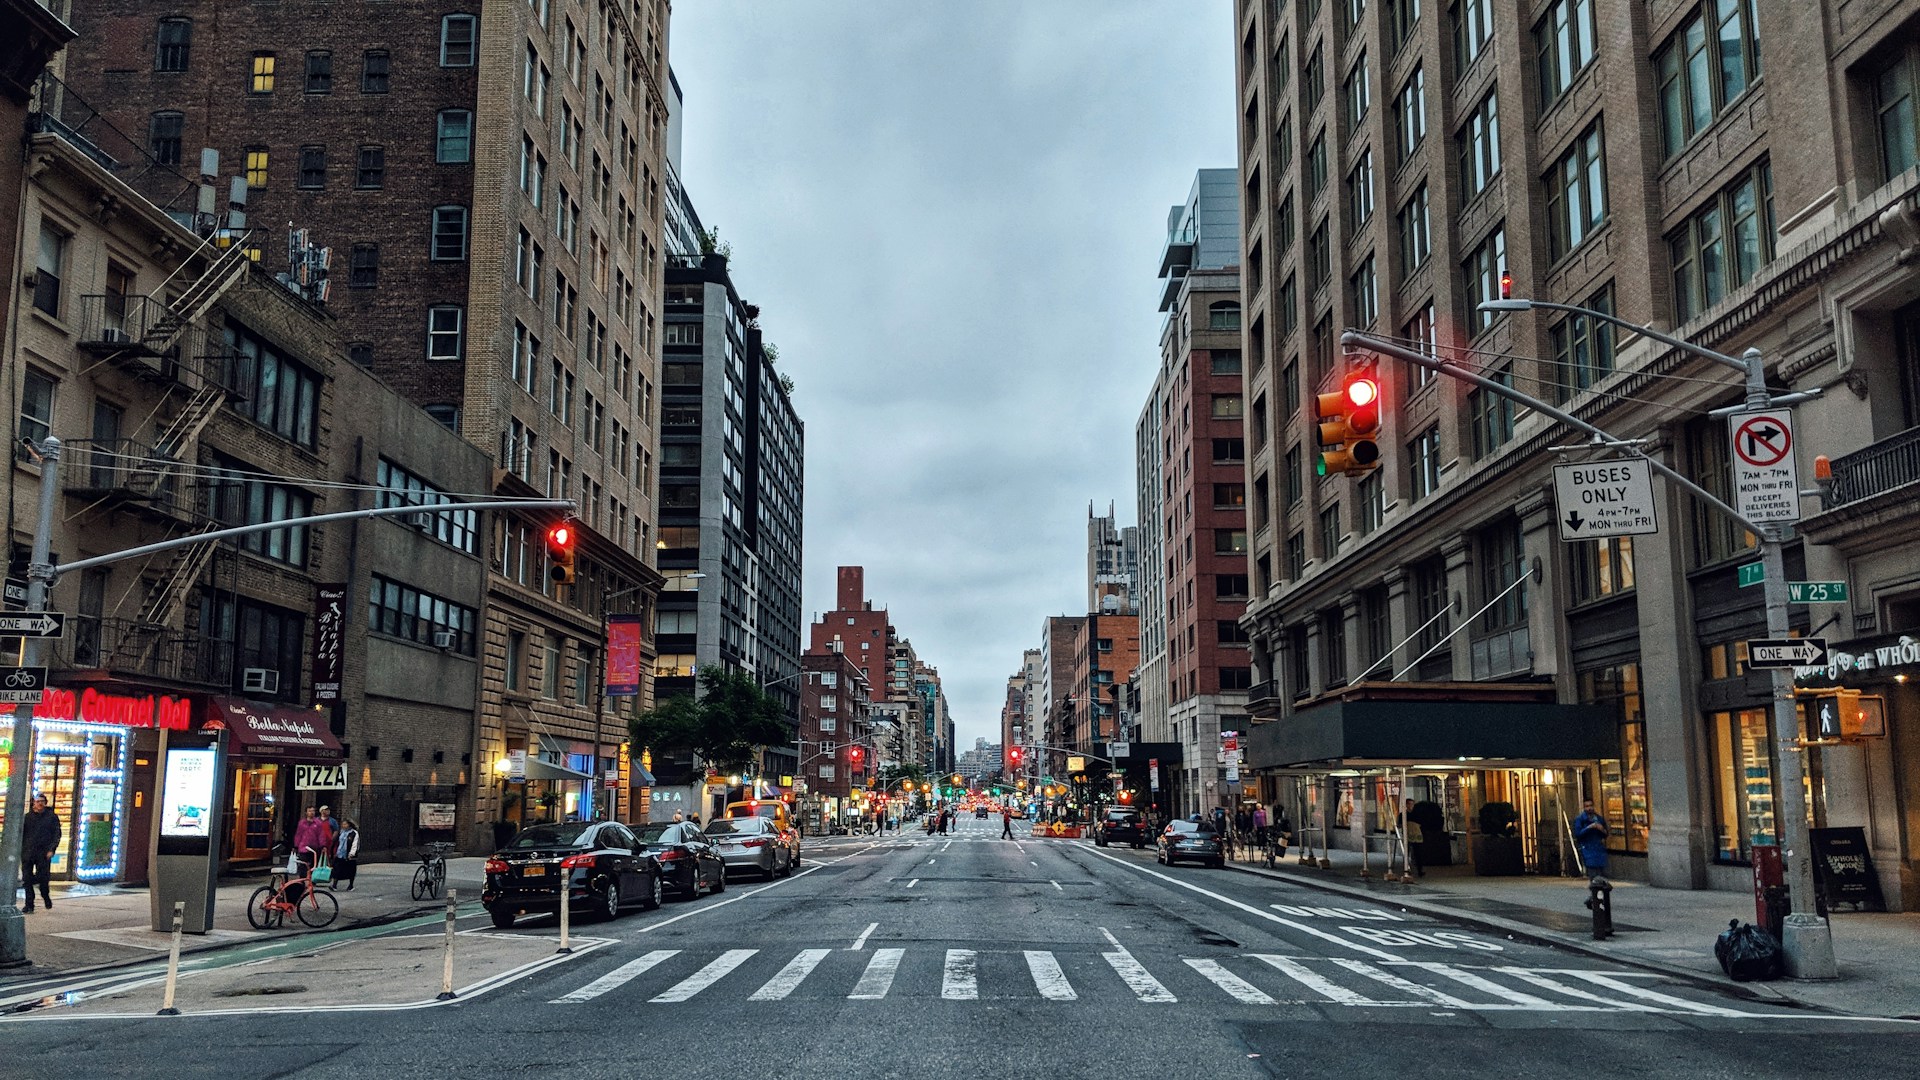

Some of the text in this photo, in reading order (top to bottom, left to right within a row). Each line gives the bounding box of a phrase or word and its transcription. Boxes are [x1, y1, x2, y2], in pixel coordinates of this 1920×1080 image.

[1573, 467, 1631, 485] BUSES
[1742, 471, 1760, 480] 7AM
[1770, 469, 1789, 478] 7PM
[1740, 483, 1759, 493] MON
[1779, 481, 1793, 489] FRI
[1582, 487, 1627, 504] ONLY
[1753, 494, 1781, 502] EXCEPT
[1745, 501, 1791, 511] DELIVERIES
[1766, 509, 1791, 517] BLOCK
[1589, 516, 1652, 530] MON THRU FRI
[1746, 567, 1751, 582] 7
[7, 586, 22, 598] ONE
[1790, 584, 1842, 600] W 25 ST
[0, 619, 52, 630] ONE WAY
[1760, 647, 1815, 659] ONE WAY
[1857, 653, 1869, 670] at
[20, 692, 40, 700] LANE
[81, 687, 154, 727] Gourmet
[159, 695, 191, 730] Deli
[246, 715, 314, 737] Bella Napoli
[296, 766, 345, 786] PIZZA
[652, 791, 681, 802] SEA
[1269, 904, 1405, 921] ONLY
[1338, 926, 1504, 951] BUS
